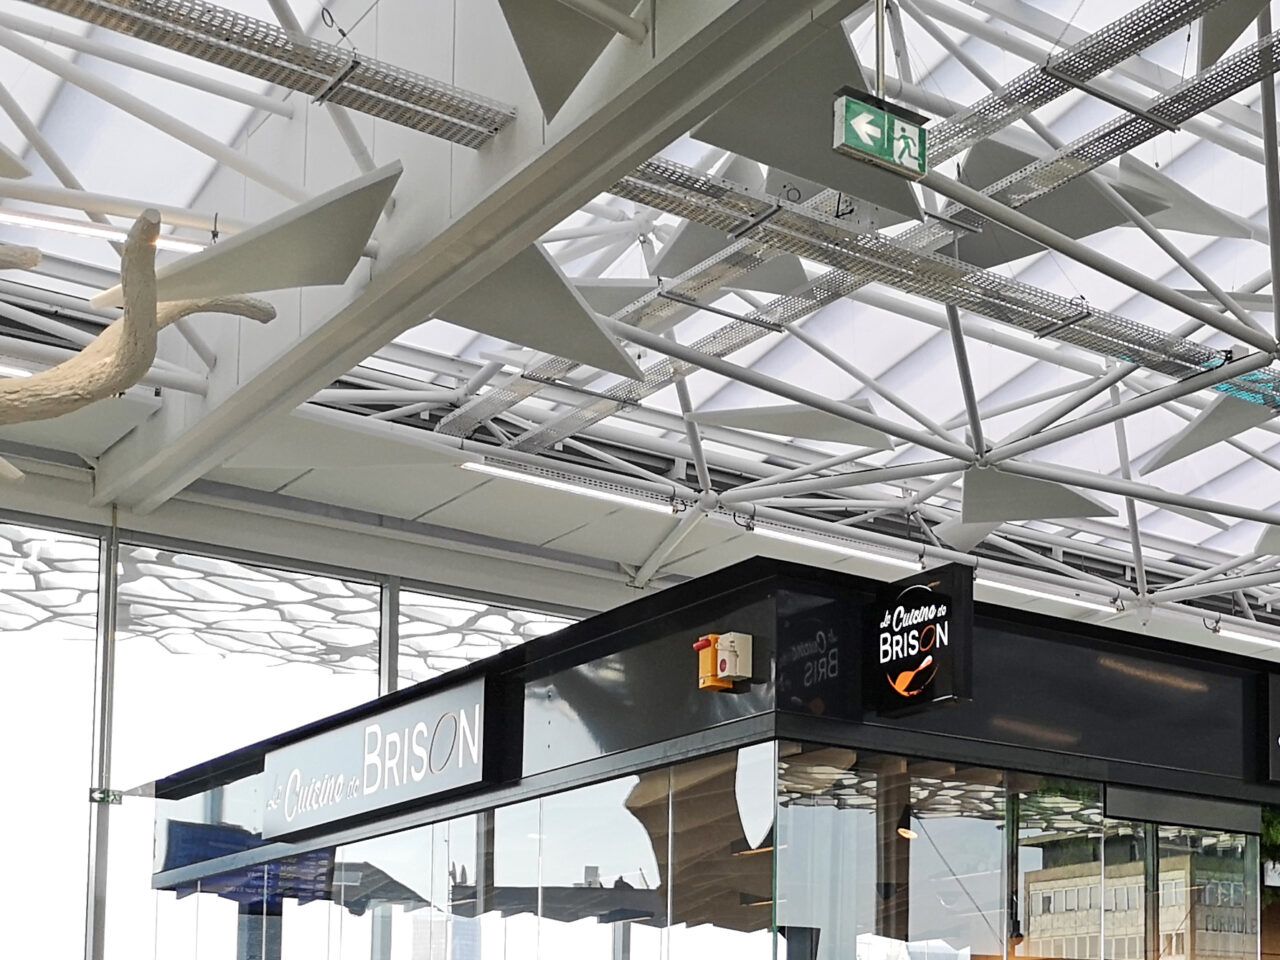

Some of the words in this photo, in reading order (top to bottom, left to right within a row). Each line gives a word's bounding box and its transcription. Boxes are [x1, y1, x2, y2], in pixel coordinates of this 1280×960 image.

[880, 620, 948, 664] BRISON
[284, 768, 344, 823] Cuisine
[364, 704, 480, 796] BRISON
